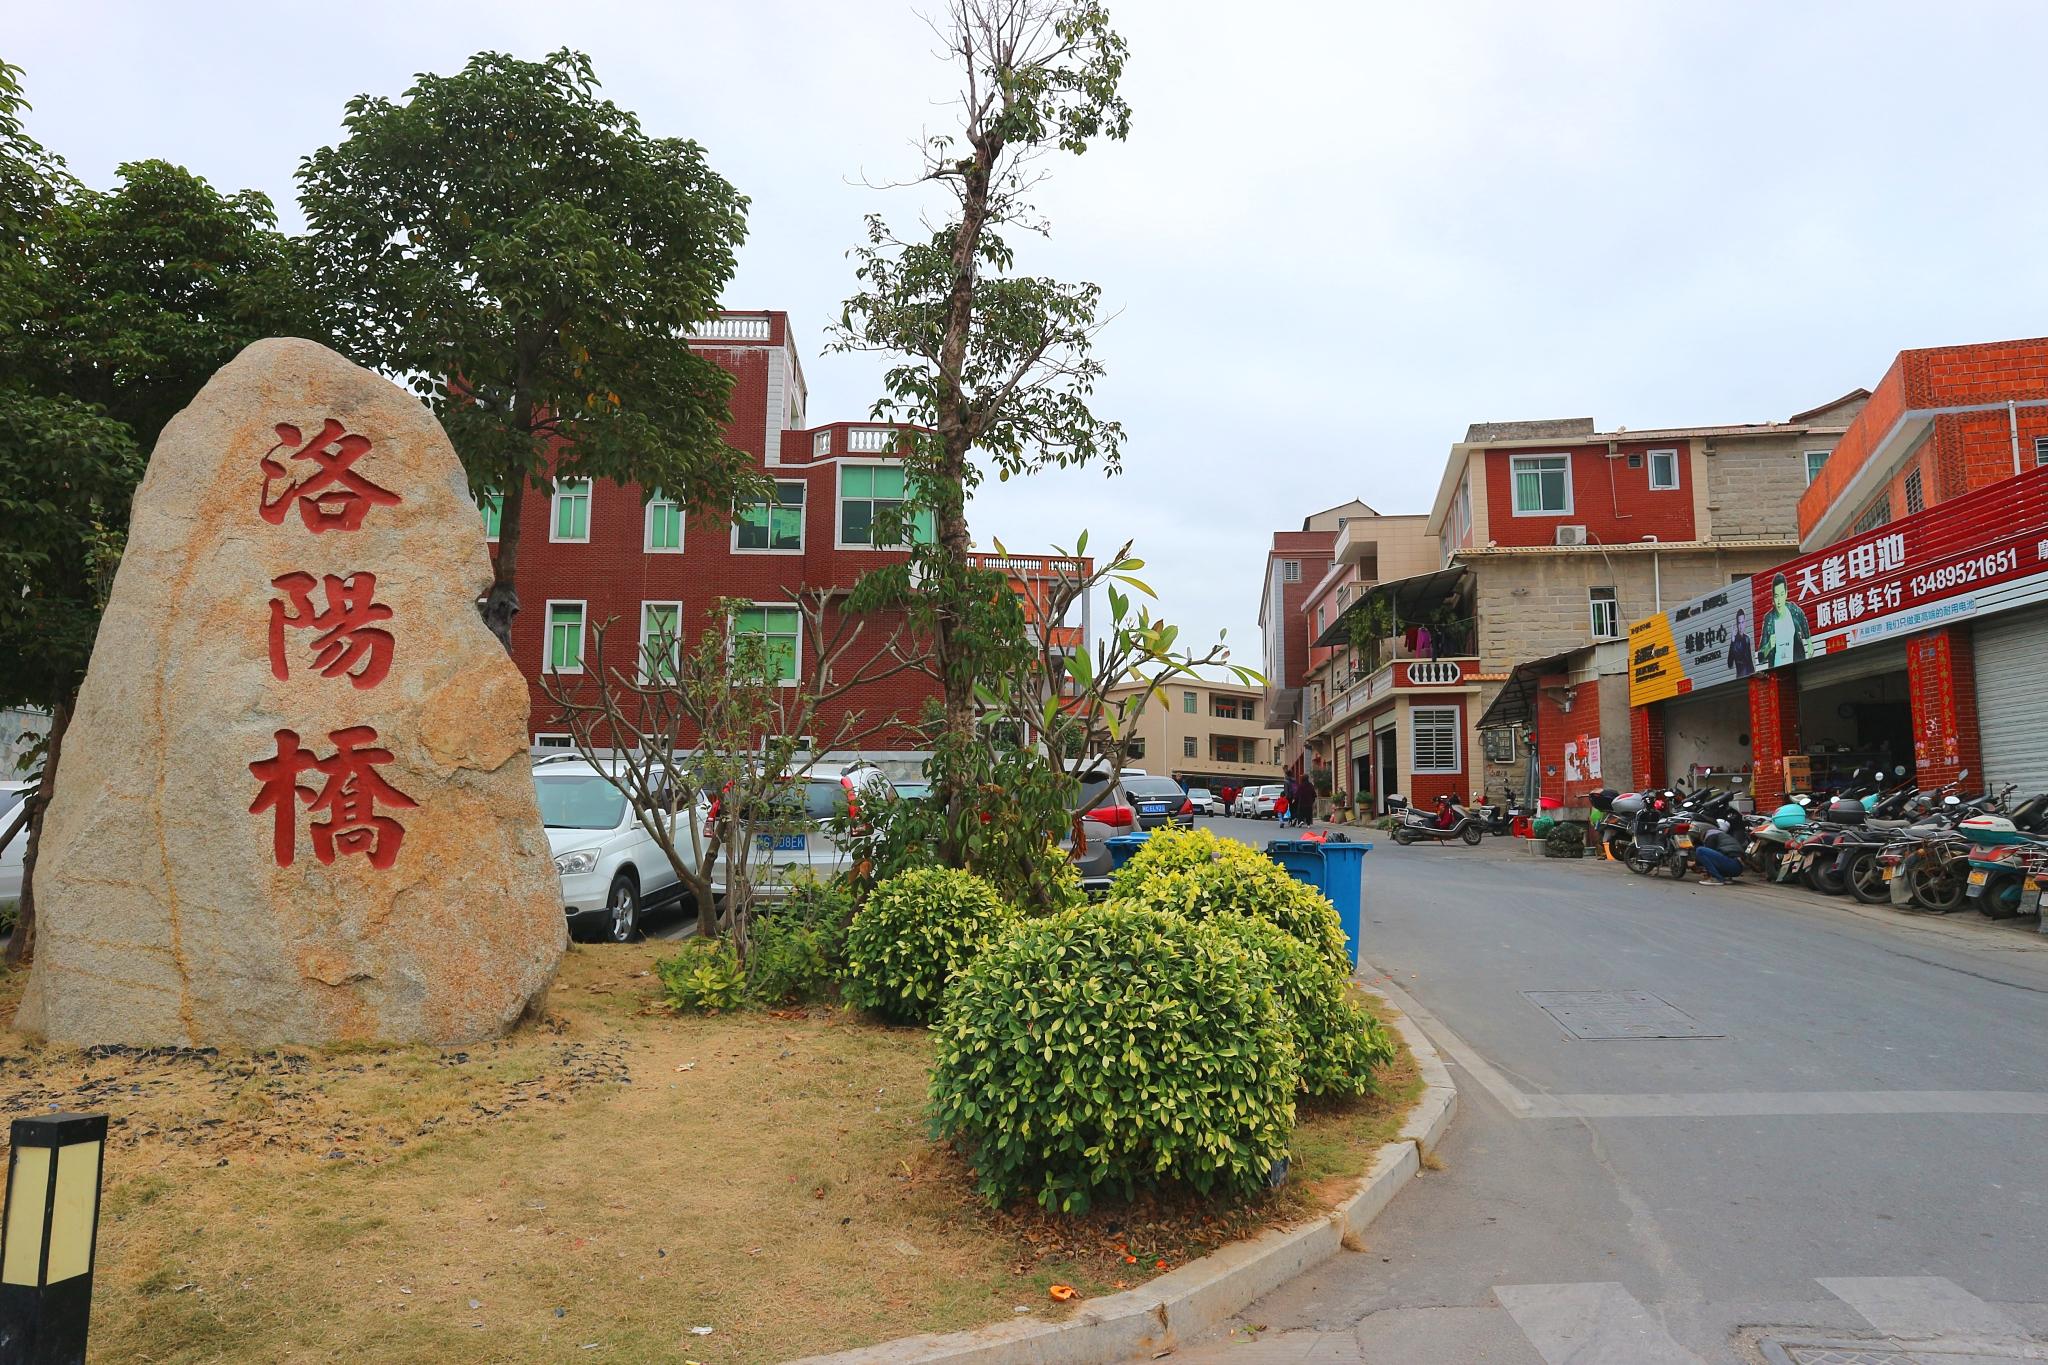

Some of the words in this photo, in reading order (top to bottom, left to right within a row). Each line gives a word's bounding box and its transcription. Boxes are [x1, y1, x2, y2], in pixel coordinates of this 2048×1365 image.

[1796, 533, 1906, 601] 天能电池
[1816, 580, 1903, 629] 顺福修车行
[1909, 547, 2018, 598] 13489521651
[248, 418, 420, 870] 洛陽橋
[1685, 624, 1728, 654] 维修中心
